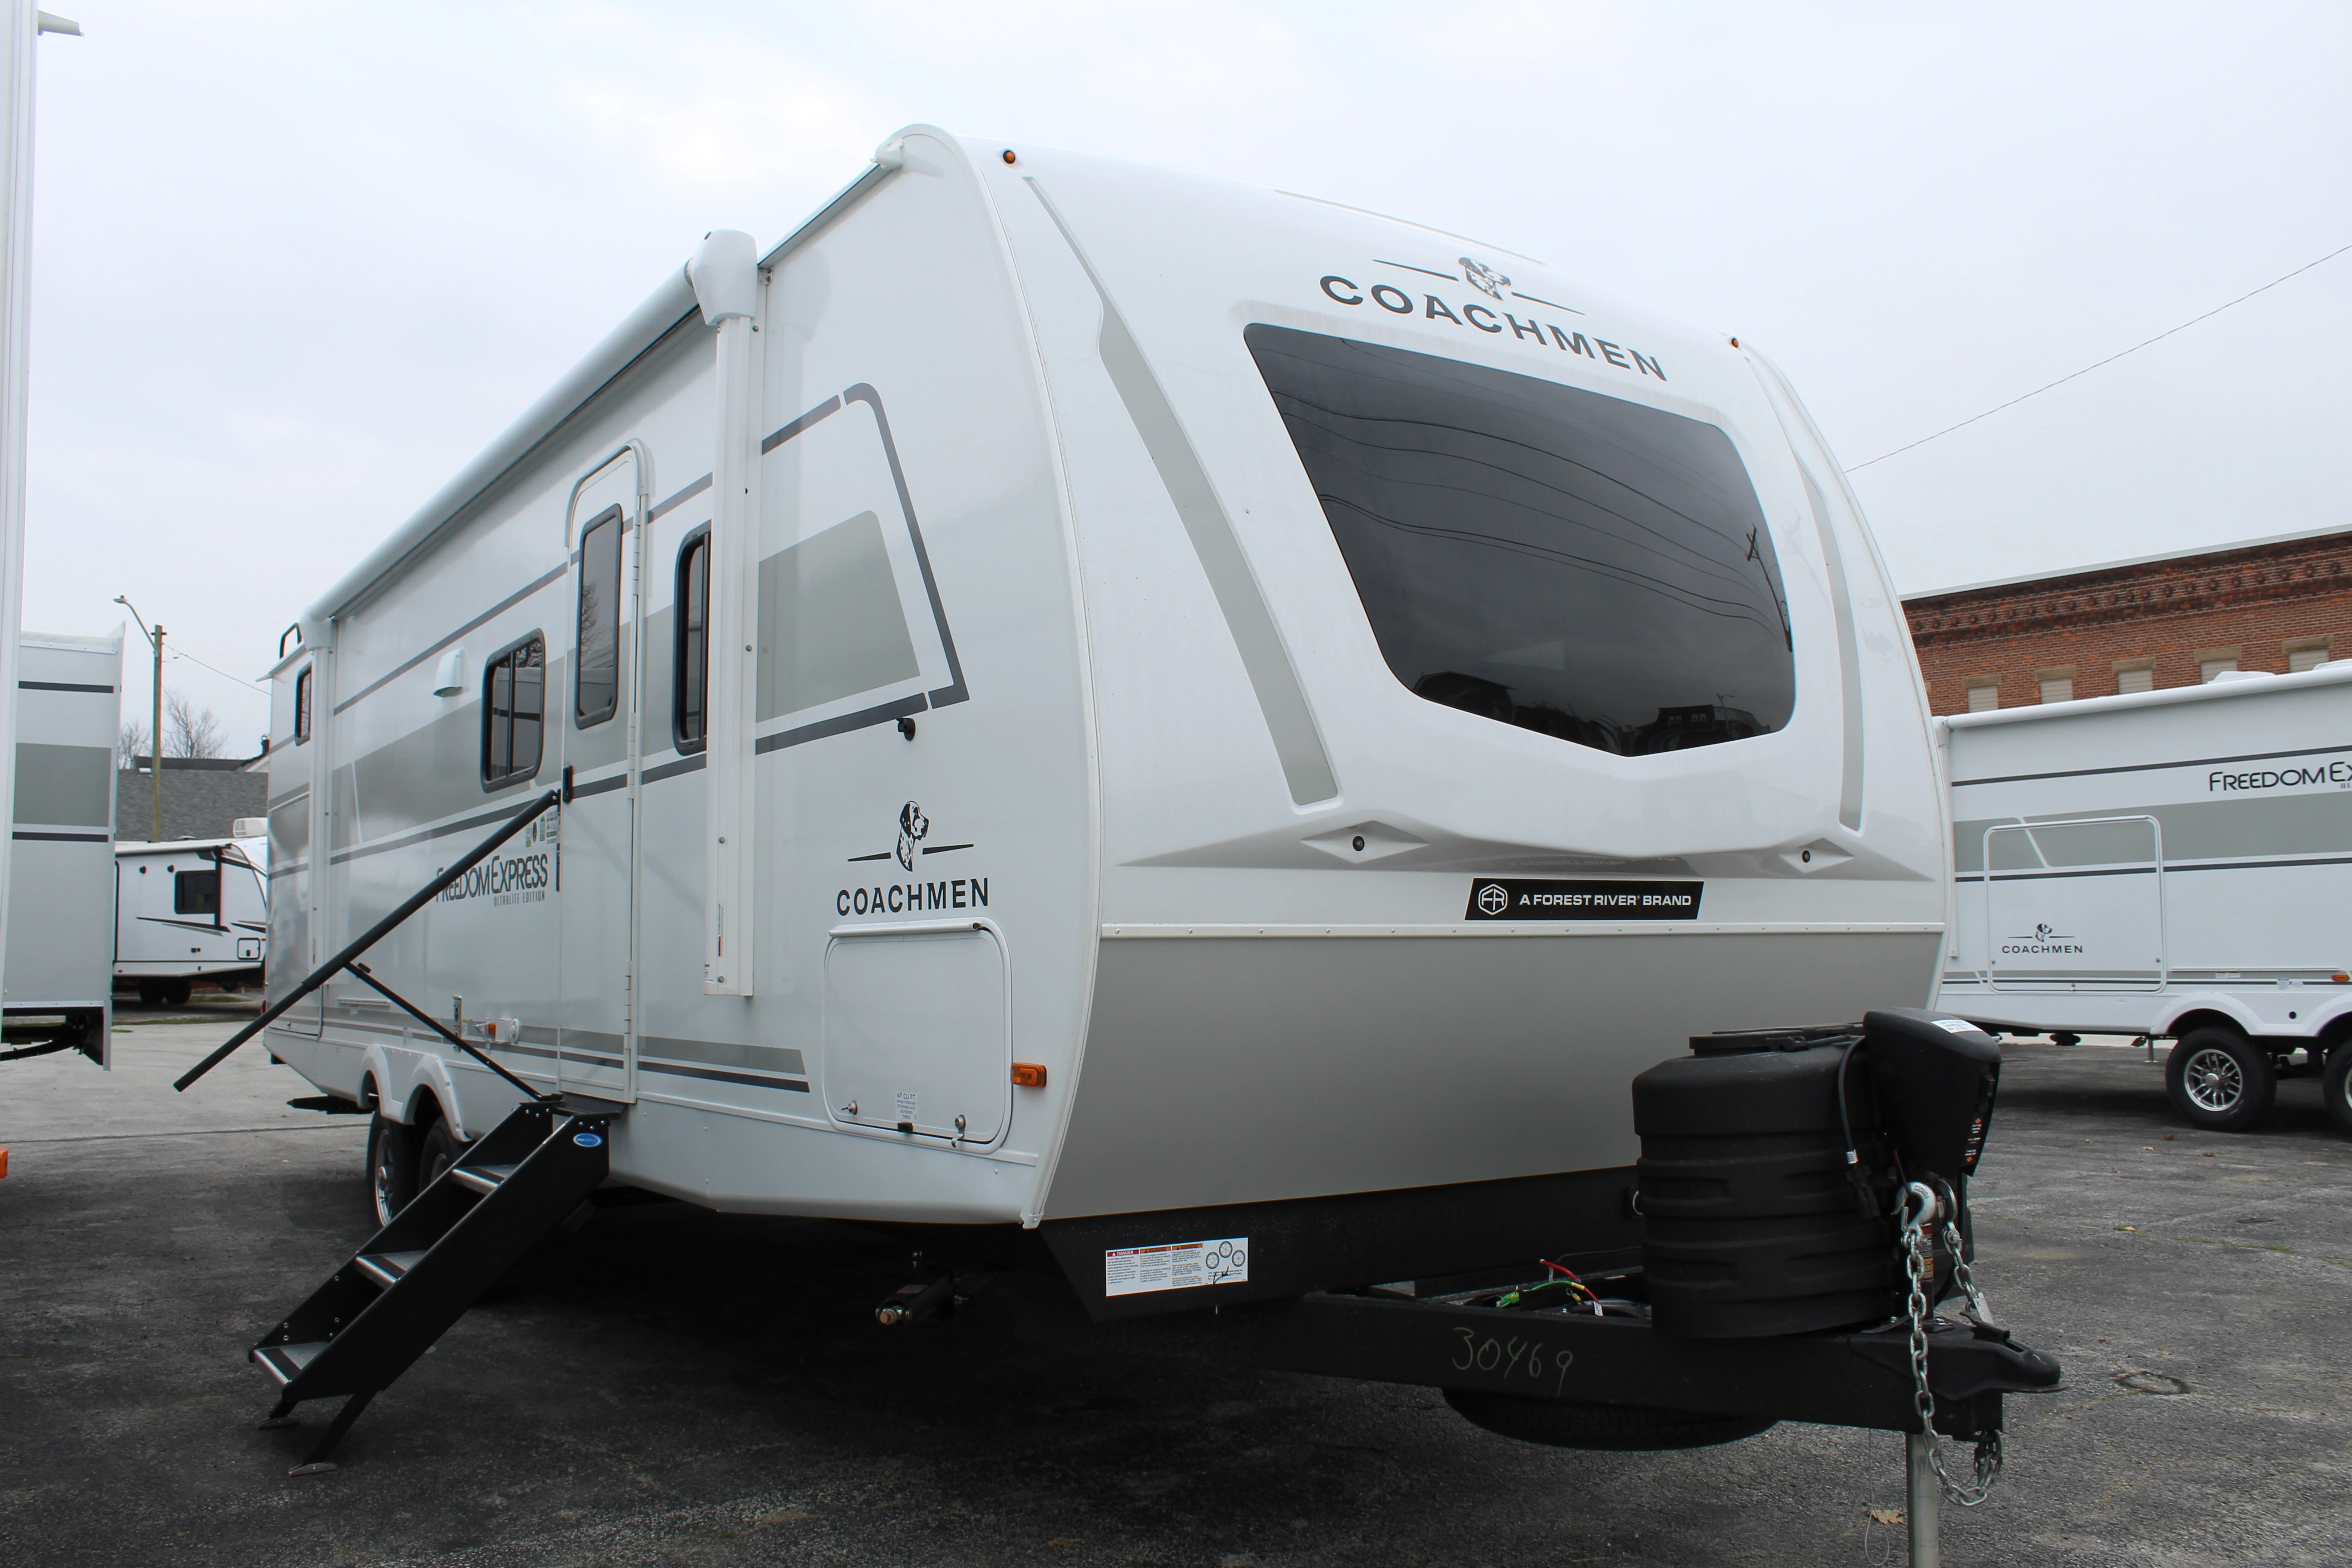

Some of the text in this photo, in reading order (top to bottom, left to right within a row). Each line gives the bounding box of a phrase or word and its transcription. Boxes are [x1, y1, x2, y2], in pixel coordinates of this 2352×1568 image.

[1320, 275, 1667, 382] COACHMEN
[494, 890, 545, 906] ULTRALITE EDITION
[836, 877, 989, 916] COACHMEN
[1519, 894, 1692, 906] A FOREST RIVER BRAND
[2001, 945, 2083, 954] COACHMEN
[1452, 1327, 1573, 1398] 30469
